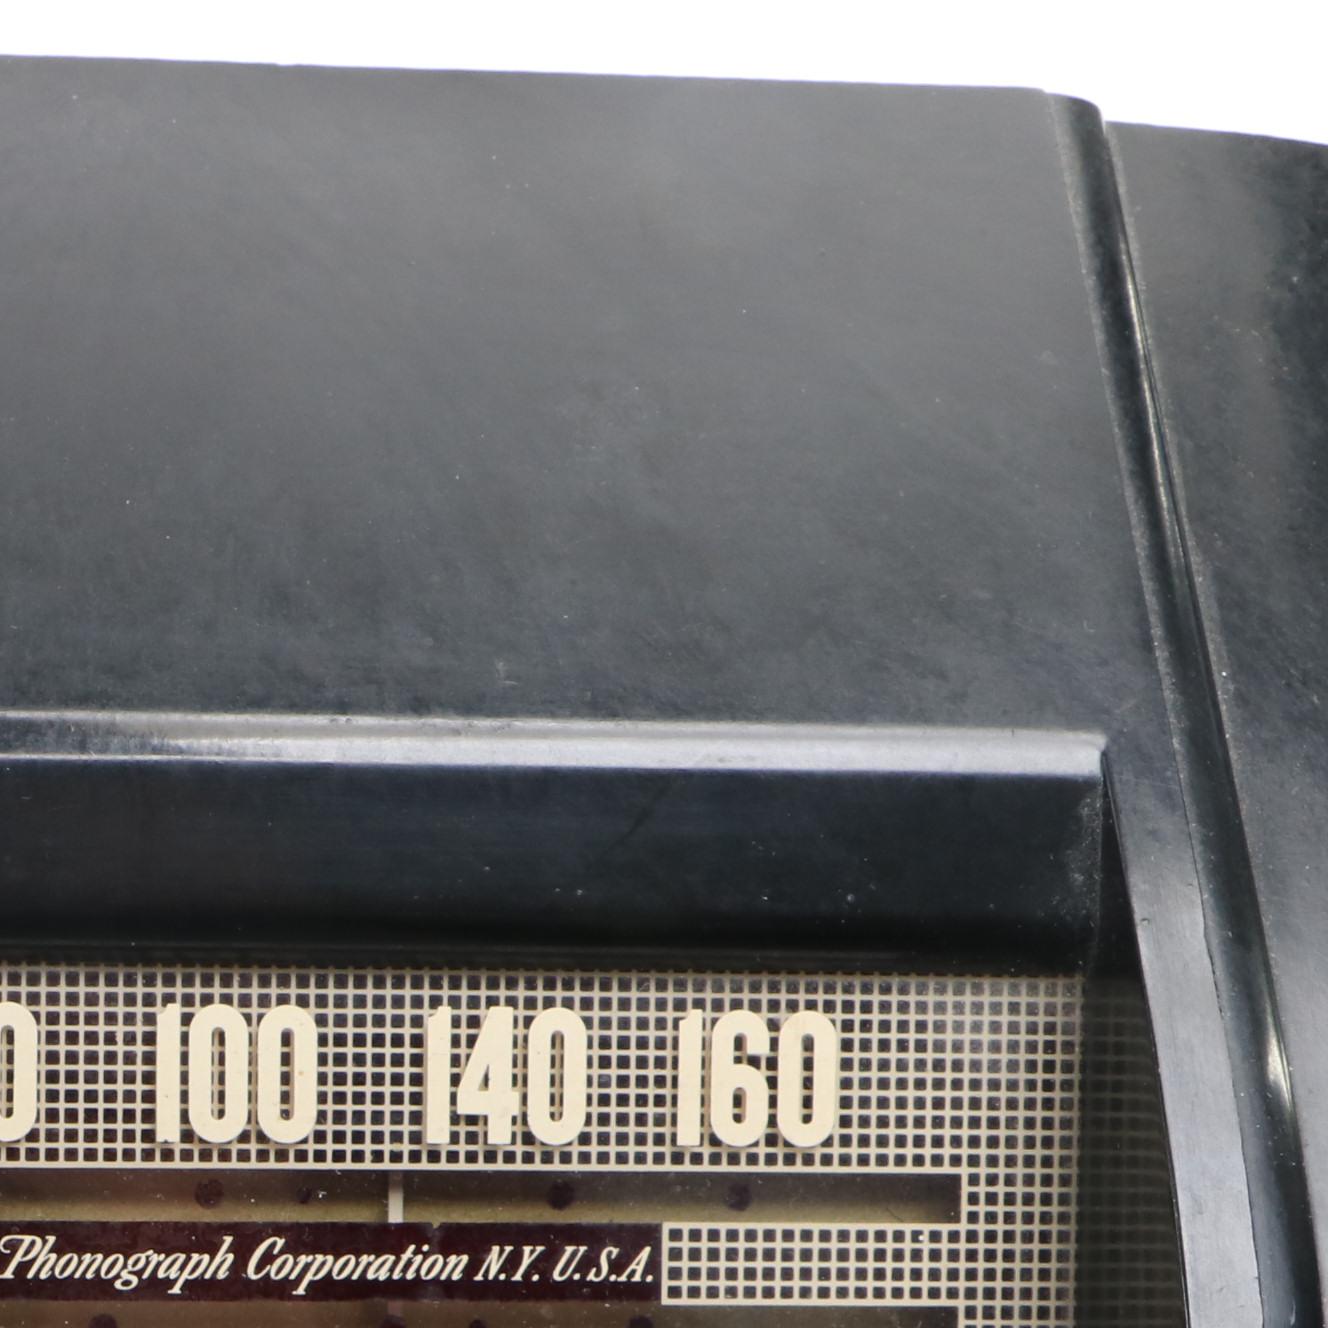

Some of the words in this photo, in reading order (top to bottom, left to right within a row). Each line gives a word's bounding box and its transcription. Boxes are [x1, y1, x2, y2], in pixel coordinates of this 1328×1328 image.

[156, 1004, 318, 1144] 100
[425, 1006, 588, 1146] 140
[677, 1009, 838, 1148] 160
[246, 1237, 470, 1295] Corporation
